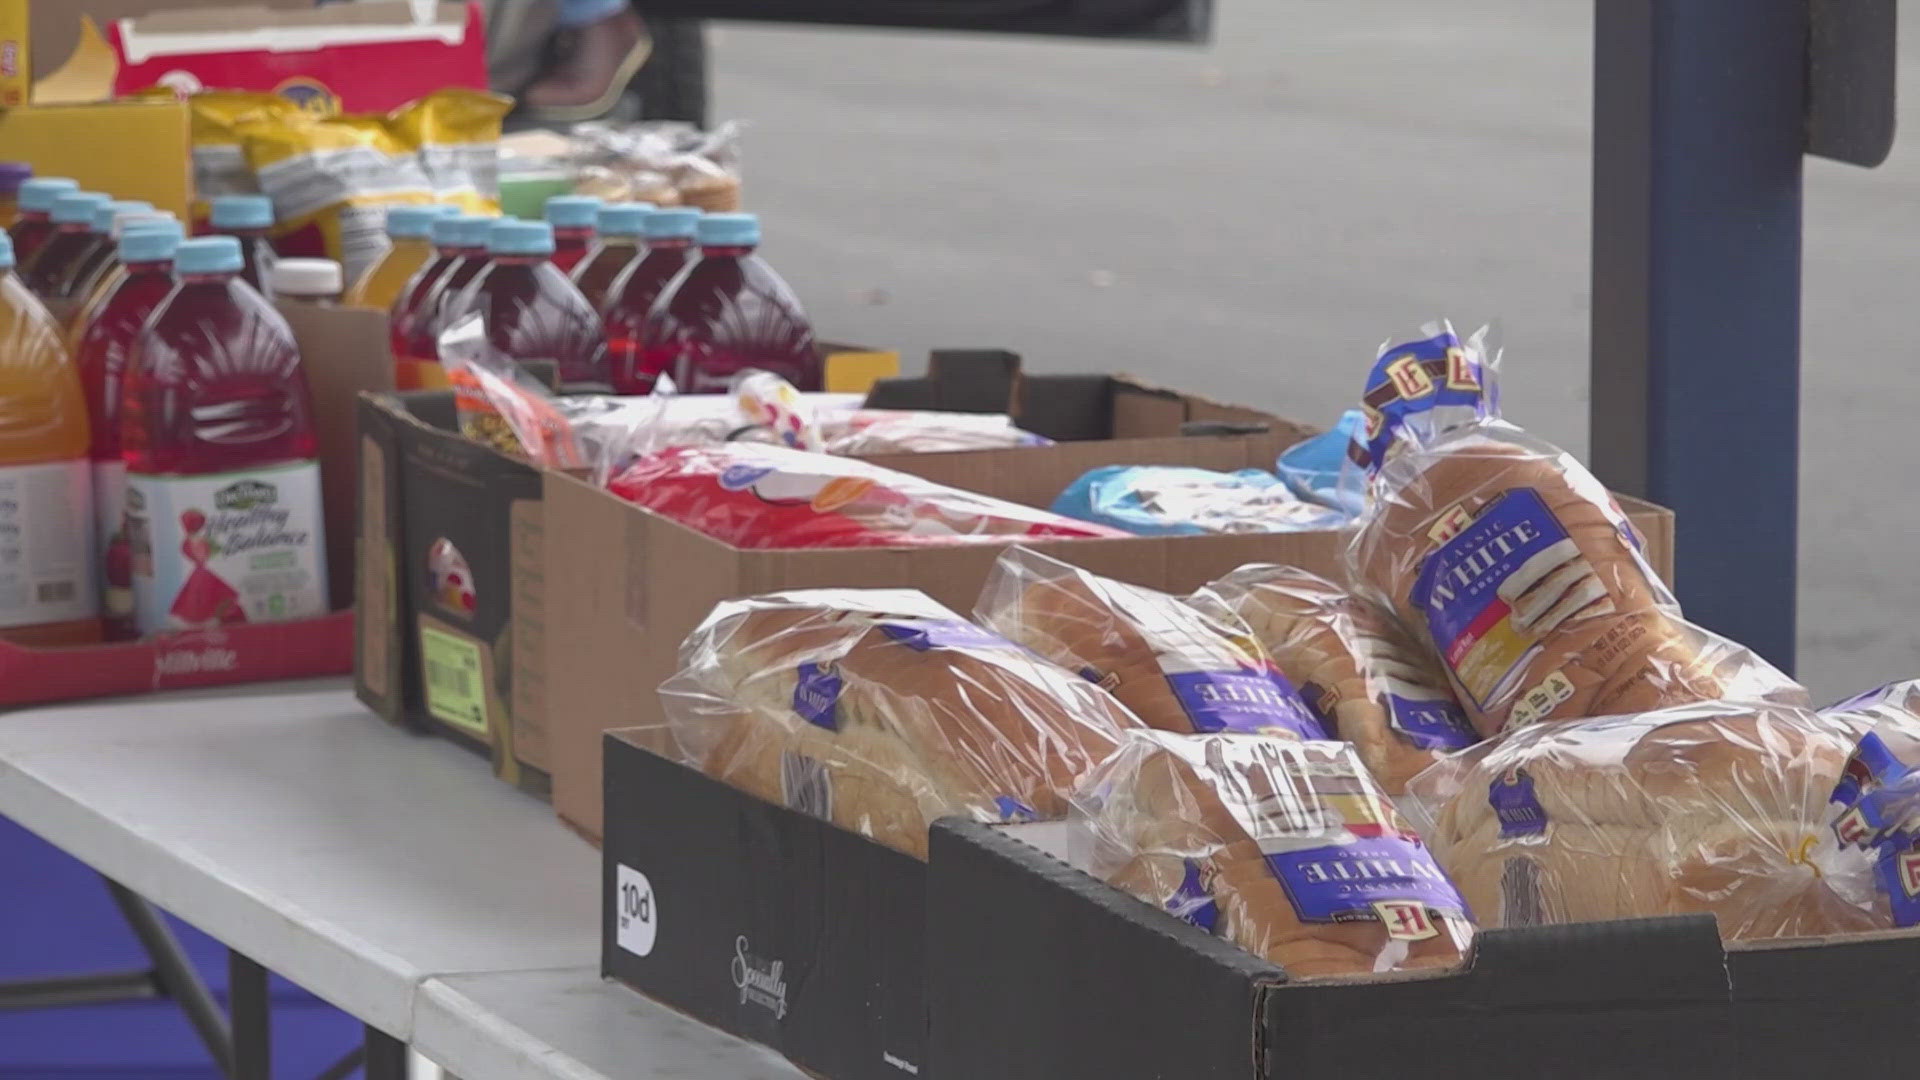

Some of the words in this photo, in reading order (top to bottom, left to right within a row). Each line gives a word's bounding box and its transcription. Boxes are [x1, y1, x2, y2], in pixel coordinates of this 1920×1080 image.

[1430, 519, 1541, 612] WHITE
[1298, 858, 1447, 885] WHITE
[622, 882, 650, 924] 10d
